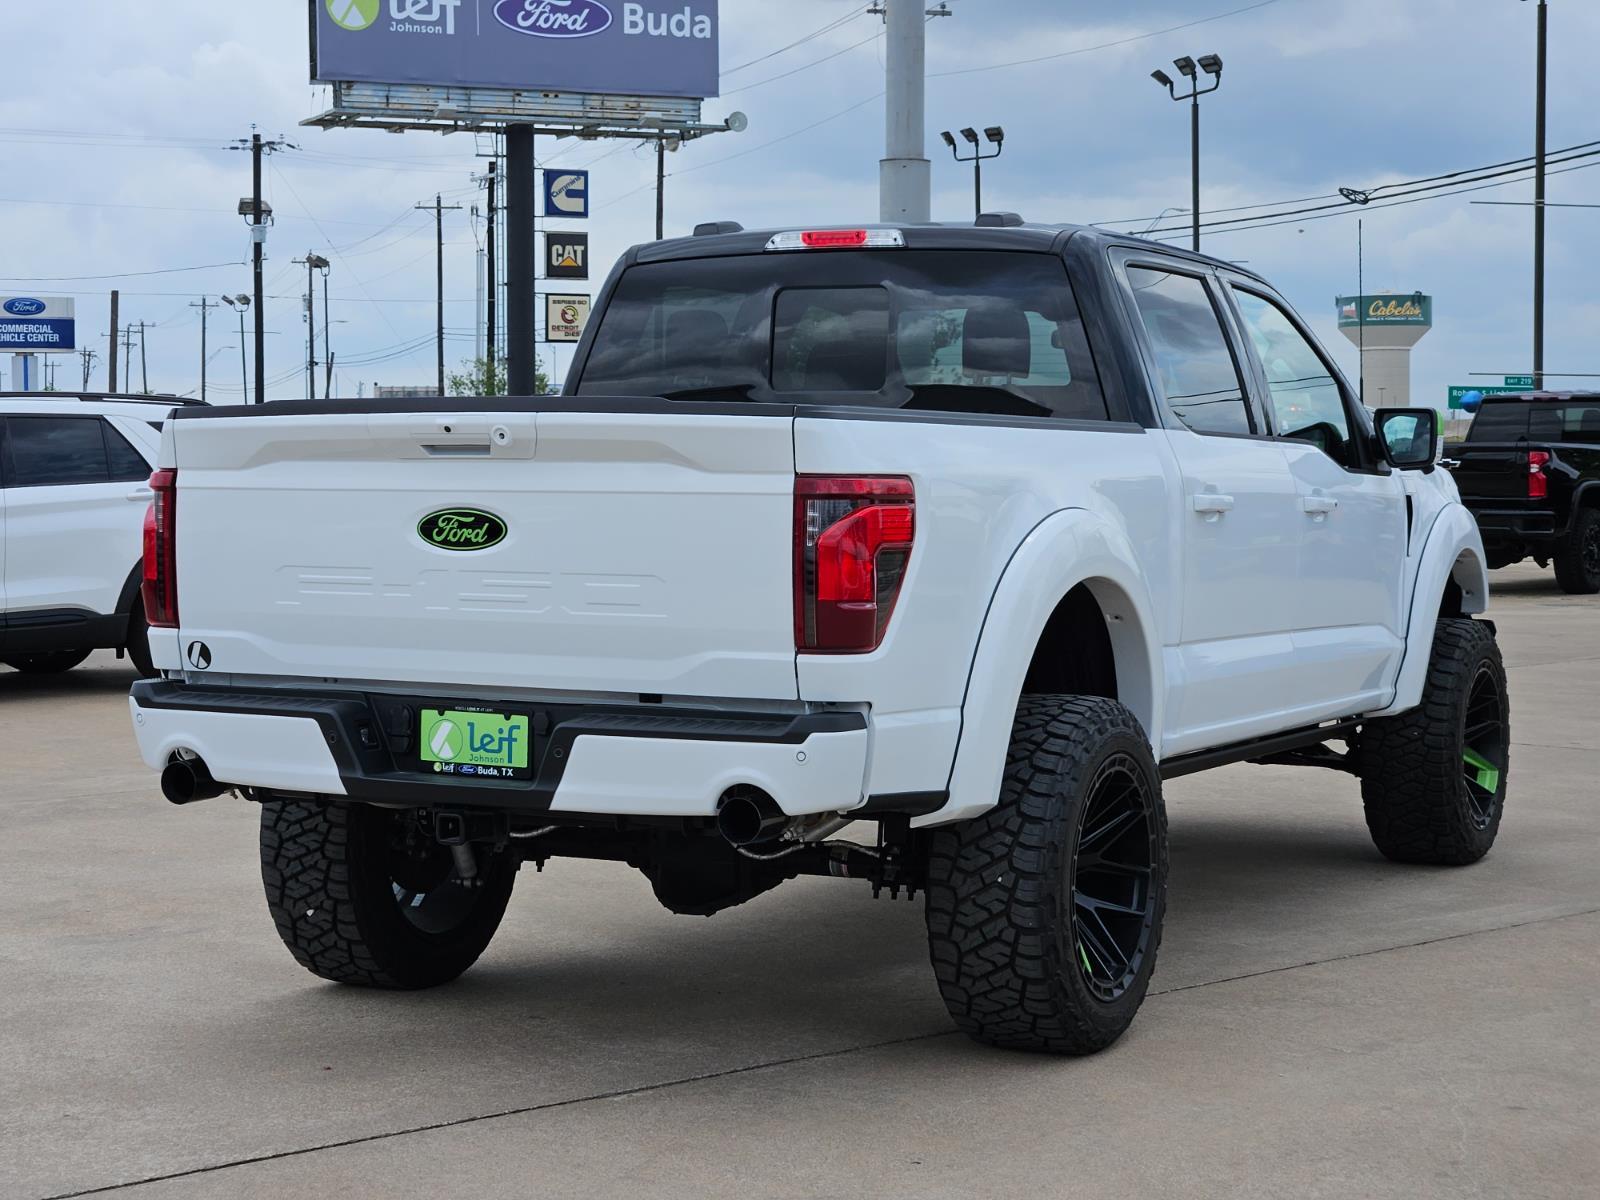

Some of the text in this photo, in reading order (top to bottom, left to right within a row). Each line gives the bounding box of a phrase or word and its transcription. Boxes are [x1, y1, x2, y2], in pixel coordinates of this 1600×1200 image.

[516, 0, 711, 38] Ford Buda
[389, 21, 443, 34] Johnson
[551, 244, 585, 267] CAT
[13, 301, 36, 311] Ford
[551, 324, 579, 332] DETROIT
[27, 333, 59, 342] CENTER
[432, 514, 489, 543] Ford
[467, 721, 521, 764] leif
[469, 753, 506, 764] Johnson
[477, 766, 500, 777] Buda,
[502, 768, 514, 777] TX
